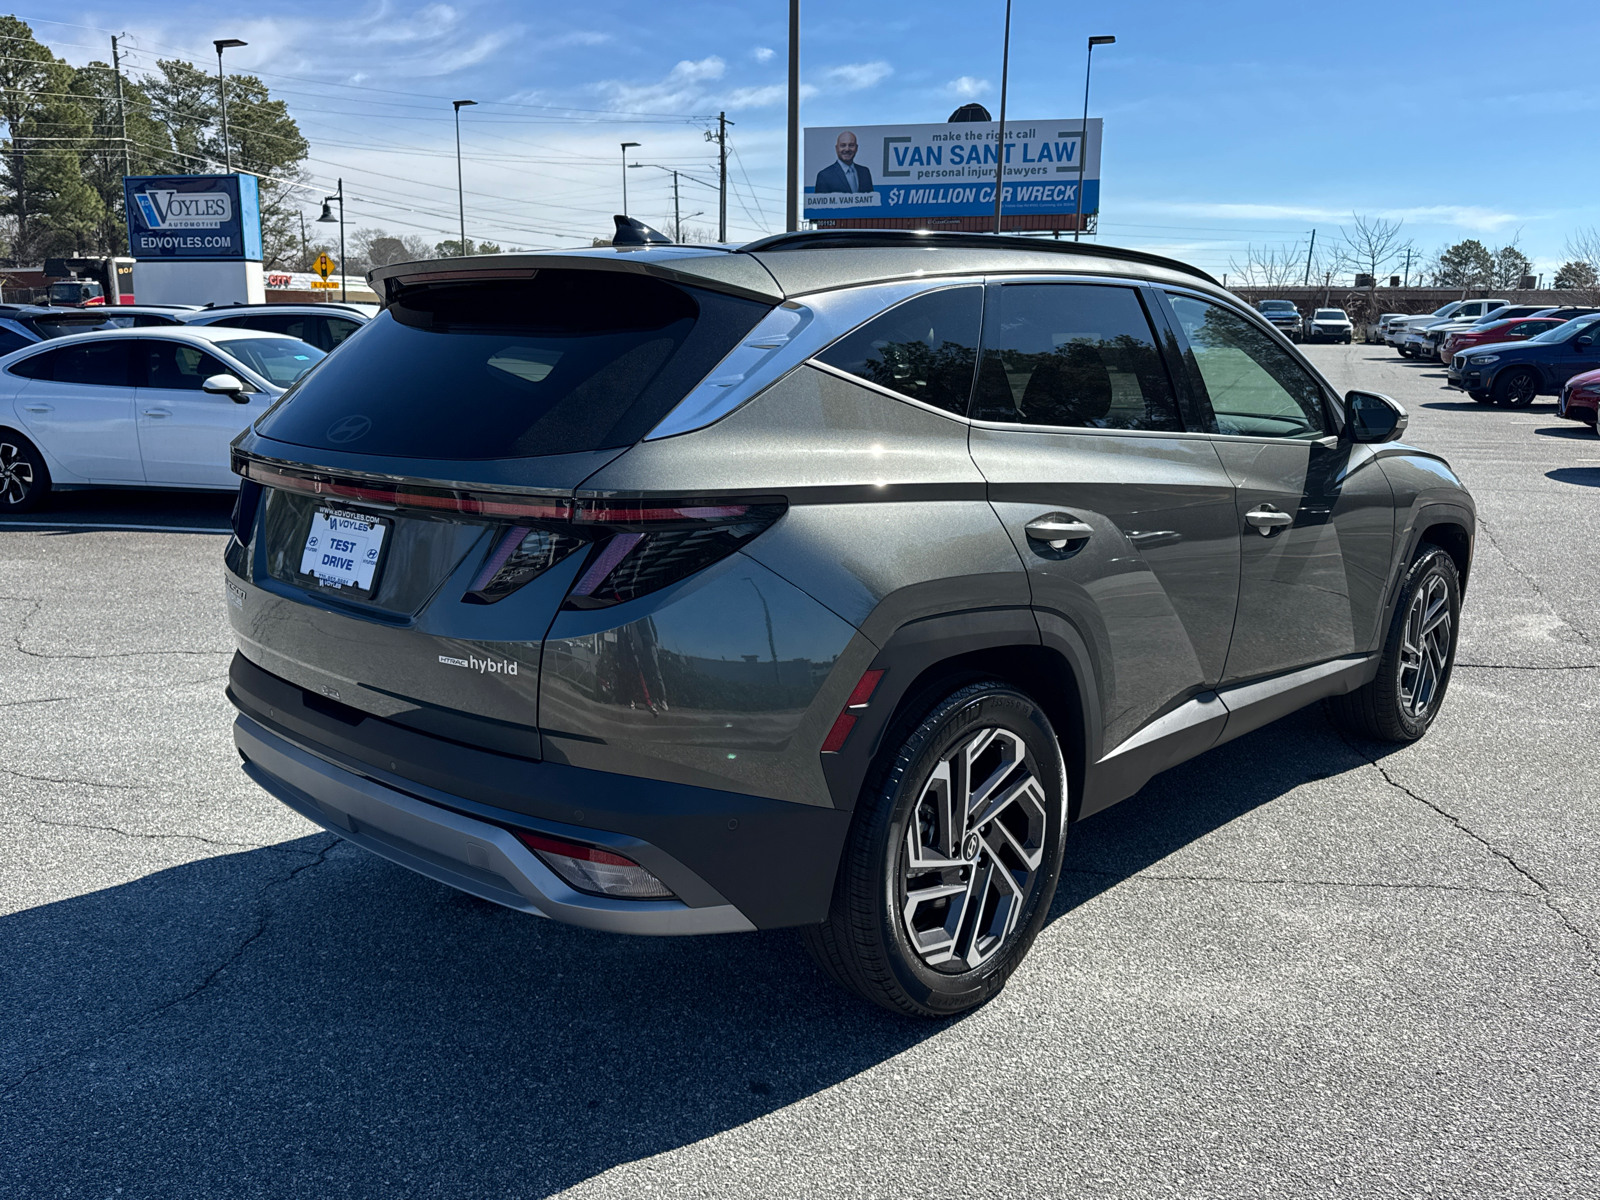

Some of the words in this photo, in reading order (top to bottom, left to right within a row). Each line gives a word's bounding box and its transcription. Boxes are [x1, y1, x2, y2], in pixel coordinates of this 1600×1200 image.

[932, 131, 961, 141] make
[965, 130, 982, 140] the
[1016, 128, 1035, 139] call
[893, 146, 942, 167] VAN
[949, 143, 1016, 165] SANT
[1022, 141, 1076, 163] LAW
[917, 166, 964, 180] personal
[967, 166, 998, 179] injury
[1003, 165, 1048, 178] lawyers
[807, 197, 828, 206] DAVID
[839, 196, 853, 204] VAN
[855, 195, 874, 204] SANT
[888, 188, 905, 206] $1
[908, 188, 976, 204] MILLION
[979, 186, 1013, 203] CAR
[1017, 185, 1078, 202] WRECK
[147, 191, 225, 224] VOYLES
[141, 236, 231, 249] EDVOYLES.COM
[268, 274, 293, 286] CITY
[339, 519, 369, 532] VOYLES
[330, 537, 357, 553] TEST
[321, 553, 354, 571] DRIVE
[439, 656, 467, 667] HTRAC
[469, 654, 518, 676] hybrid
